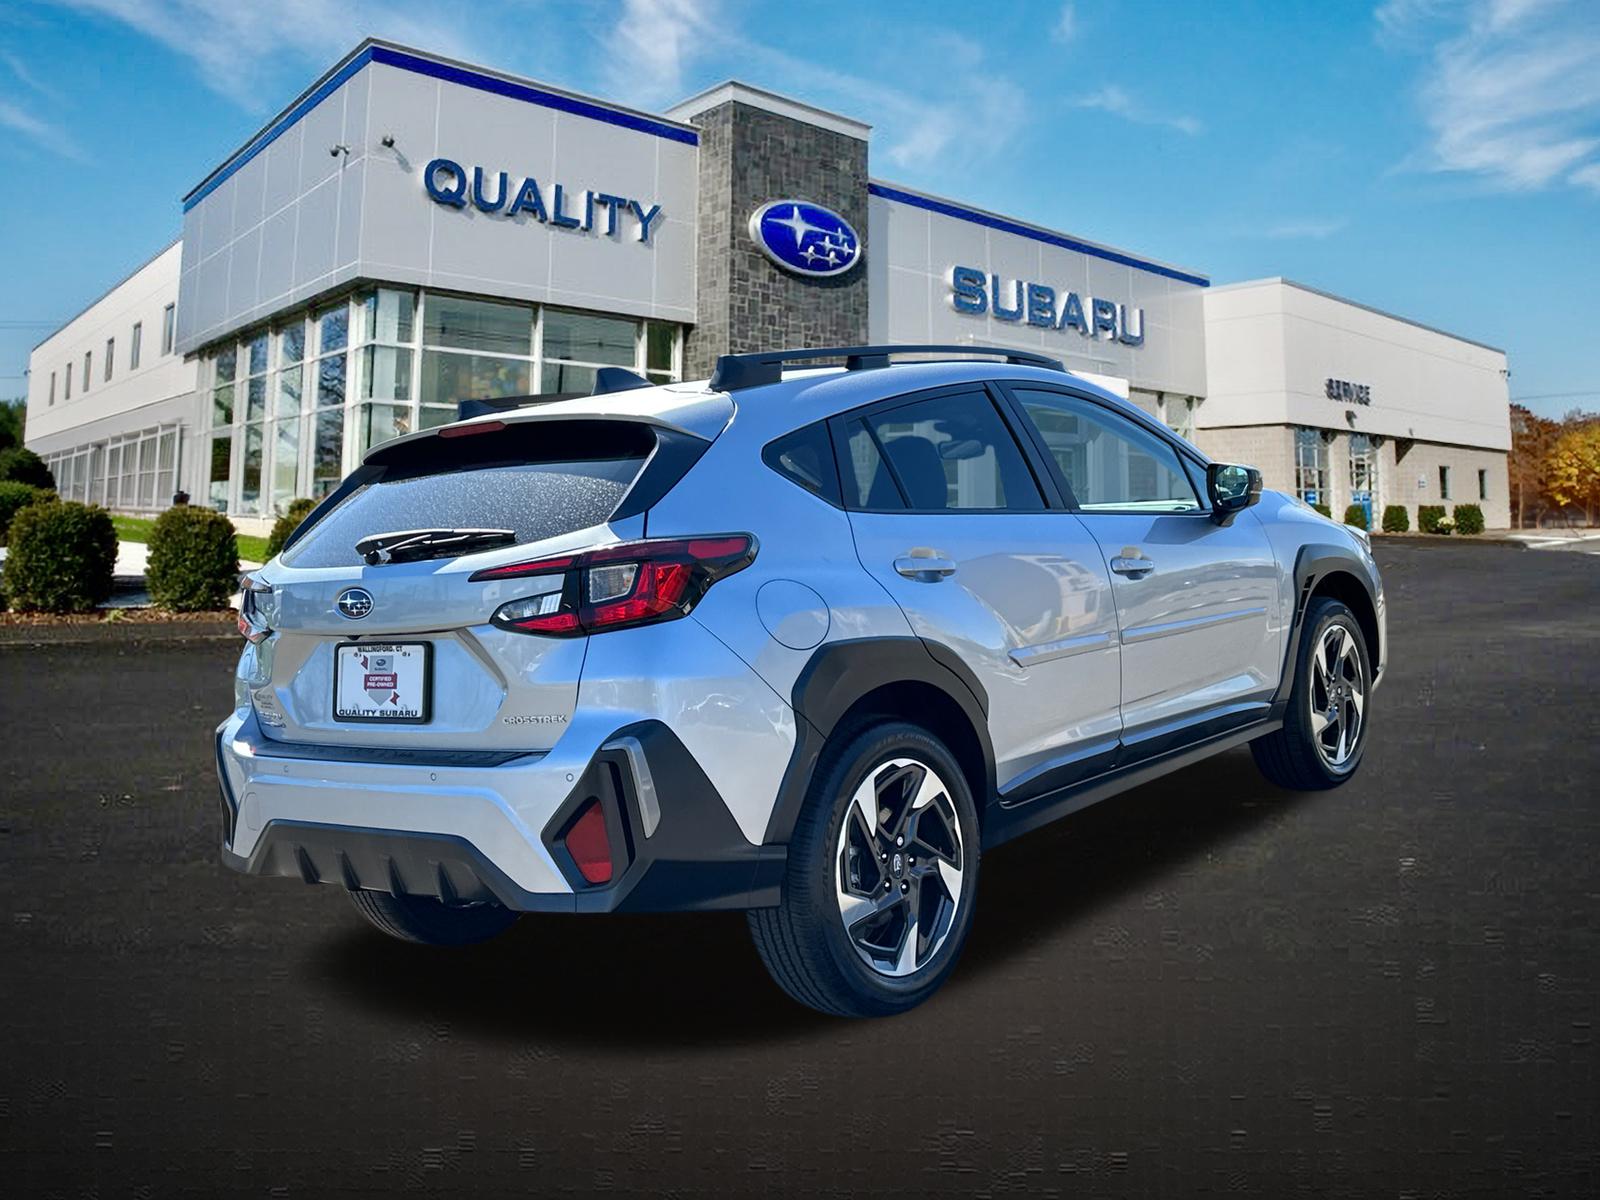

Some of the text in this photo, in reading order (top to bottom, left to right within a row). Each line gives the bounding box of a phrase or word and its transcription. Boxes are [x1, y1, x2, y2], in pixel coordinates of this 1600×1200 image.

[423, 158, 662, 243] QUALITY
[949, 265, 1146, 347] SUBARU
[1325, 378, 1371, 406] SERVICE
[502, 714, 567, 725] CROSSTREK
